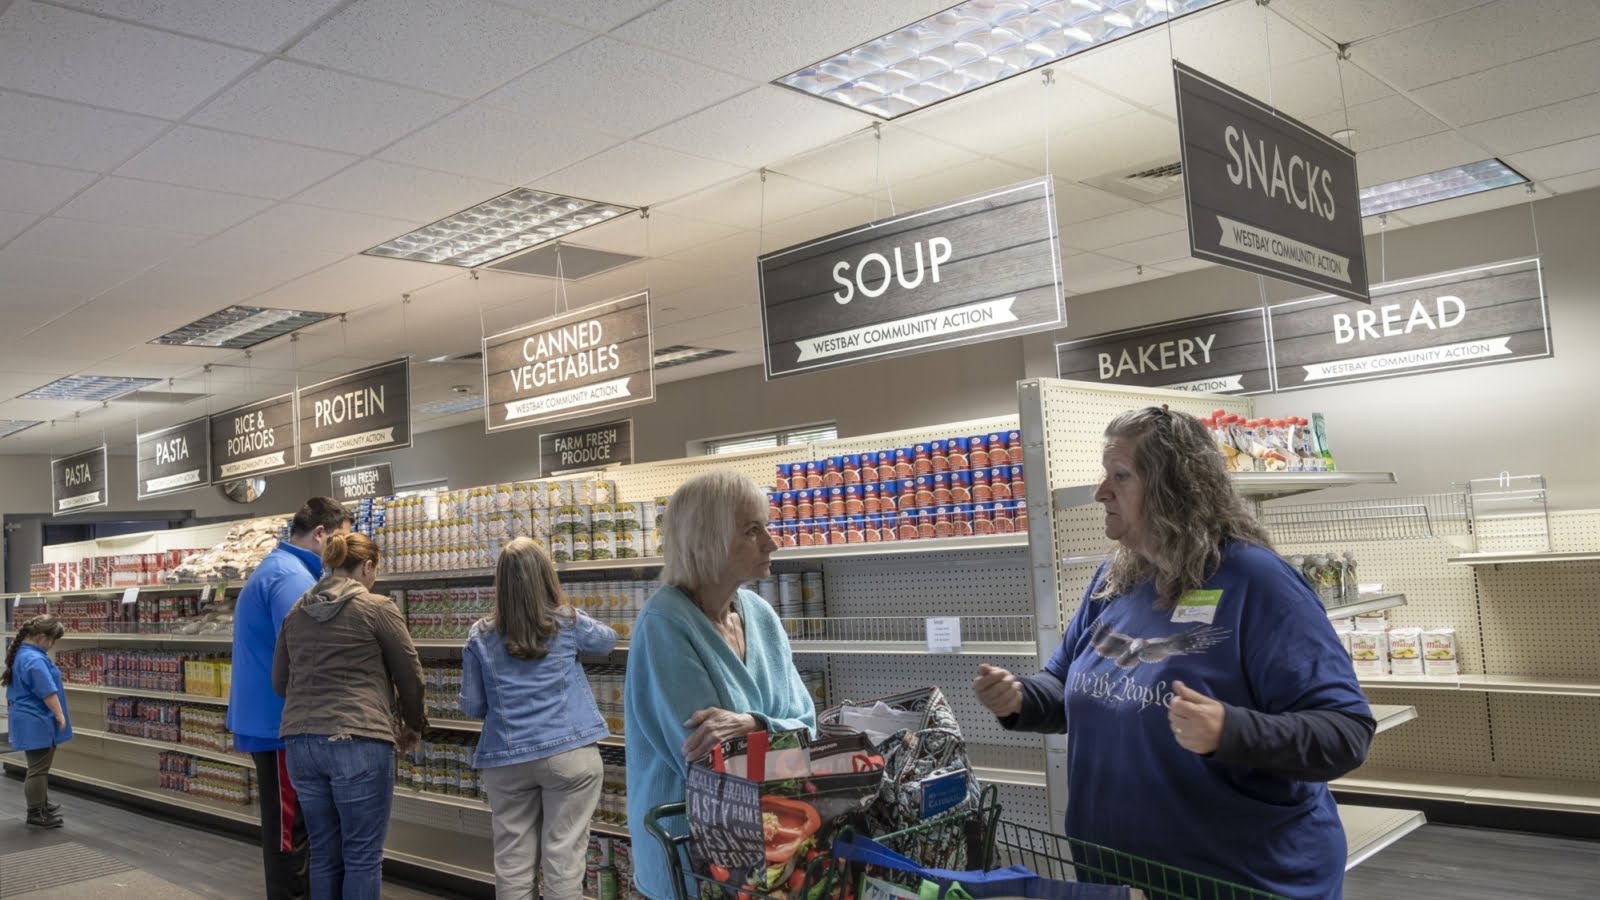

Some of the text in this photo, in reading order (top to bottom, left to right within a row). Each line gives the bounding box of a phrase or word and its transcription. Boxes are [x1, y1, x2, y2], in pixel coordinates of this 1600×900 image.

[1224, 125, 1335, 222] SNACKS
[1232, 226, 1342, 275] WESTBAY COMMUNITY ACTION
[832, 236, 952, 305] SOUP
[812, 307, 993, 354] WESTBAY COMMUNITY ACTION
[1333, 295, 1466, 344] BREAD
[523, 320, 602, 362] CANNED
[510, 344, 620, 393] VEGETABLES
[1098, 334, 1216, 380] BAKERY
[1321, 343, 1490, 376] WESTBAY COMMUNITY ACTION
[516, 384, 618, 414] WESTBAY COMMUNITY ACTION
[1192, 380, 1227, 392] ACTION
[314, 384, 385, 428] PROTEIN
[234, 410, 265, 436] RICE &
[156, 436, 189, 466] PASTA
[228, 428, 275, 456] POTATOES
[336, 436, 366, 449] COMMUNITY
[366, 432, 386, 444] ACTION
[555, 428, 616, 453] FARM FRESH
[562, 444, 610, 465] PRODUCE
[65, 464, 92, 487] PASTA
[340, 470, 380, 488] FARM FRESH
[344, 482, 376, 498] PRODUCE
